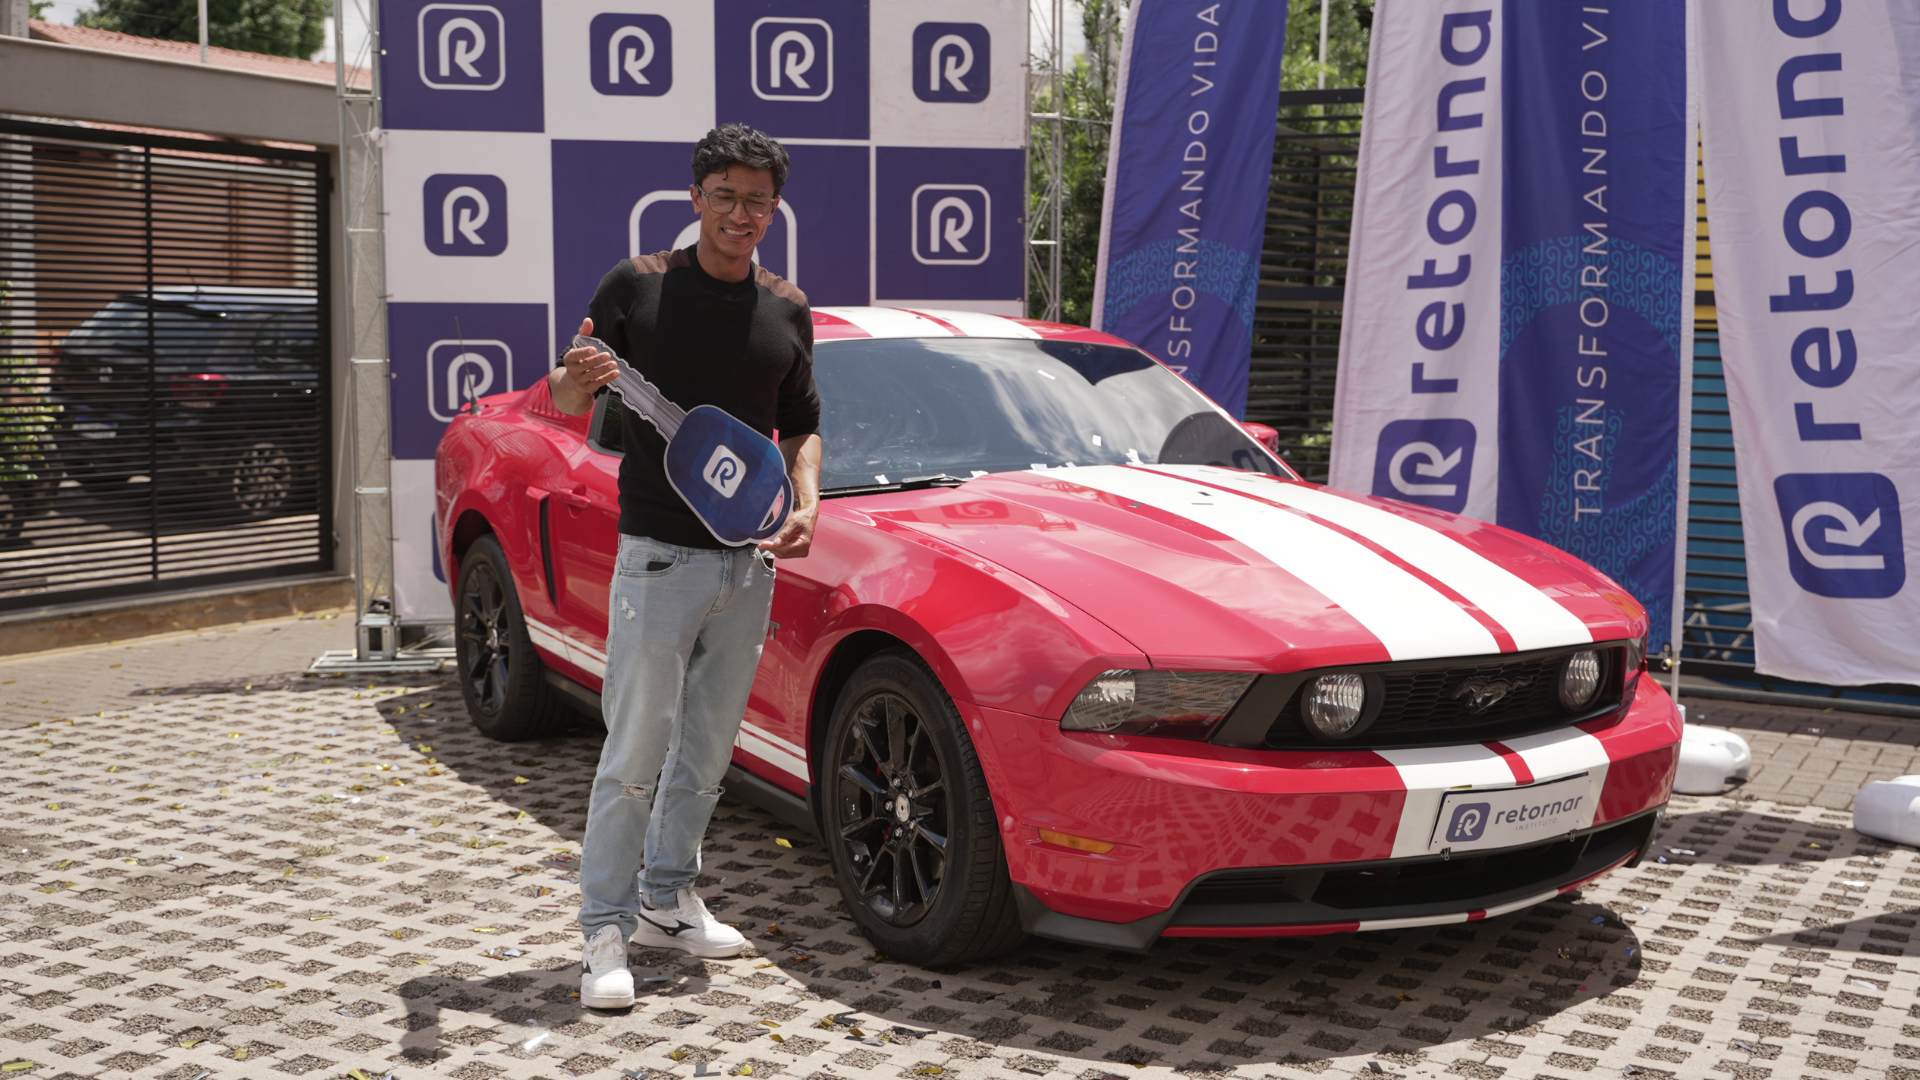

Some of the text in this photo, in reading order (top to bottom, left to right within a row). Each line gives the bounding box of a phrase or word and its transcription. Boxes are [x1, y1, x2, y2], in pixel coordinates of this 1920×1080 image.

[438, 18, 485, 77] R
[608, 26, 655, 85] R
[770, 30, 815, 88] R
[930, 34, 974, 91] R
[442, 186, 490, 245] R
[930, 196, 974, 253] R
[1388, 9, 1493, 496] R retorna
[1573, 6, 1609, 523] TRANSFORMANDO VI
[711, 456, 738, 489] R
[1790, 501, 1886, 570] R
[1454, 795, 1583, 837] R retornar
